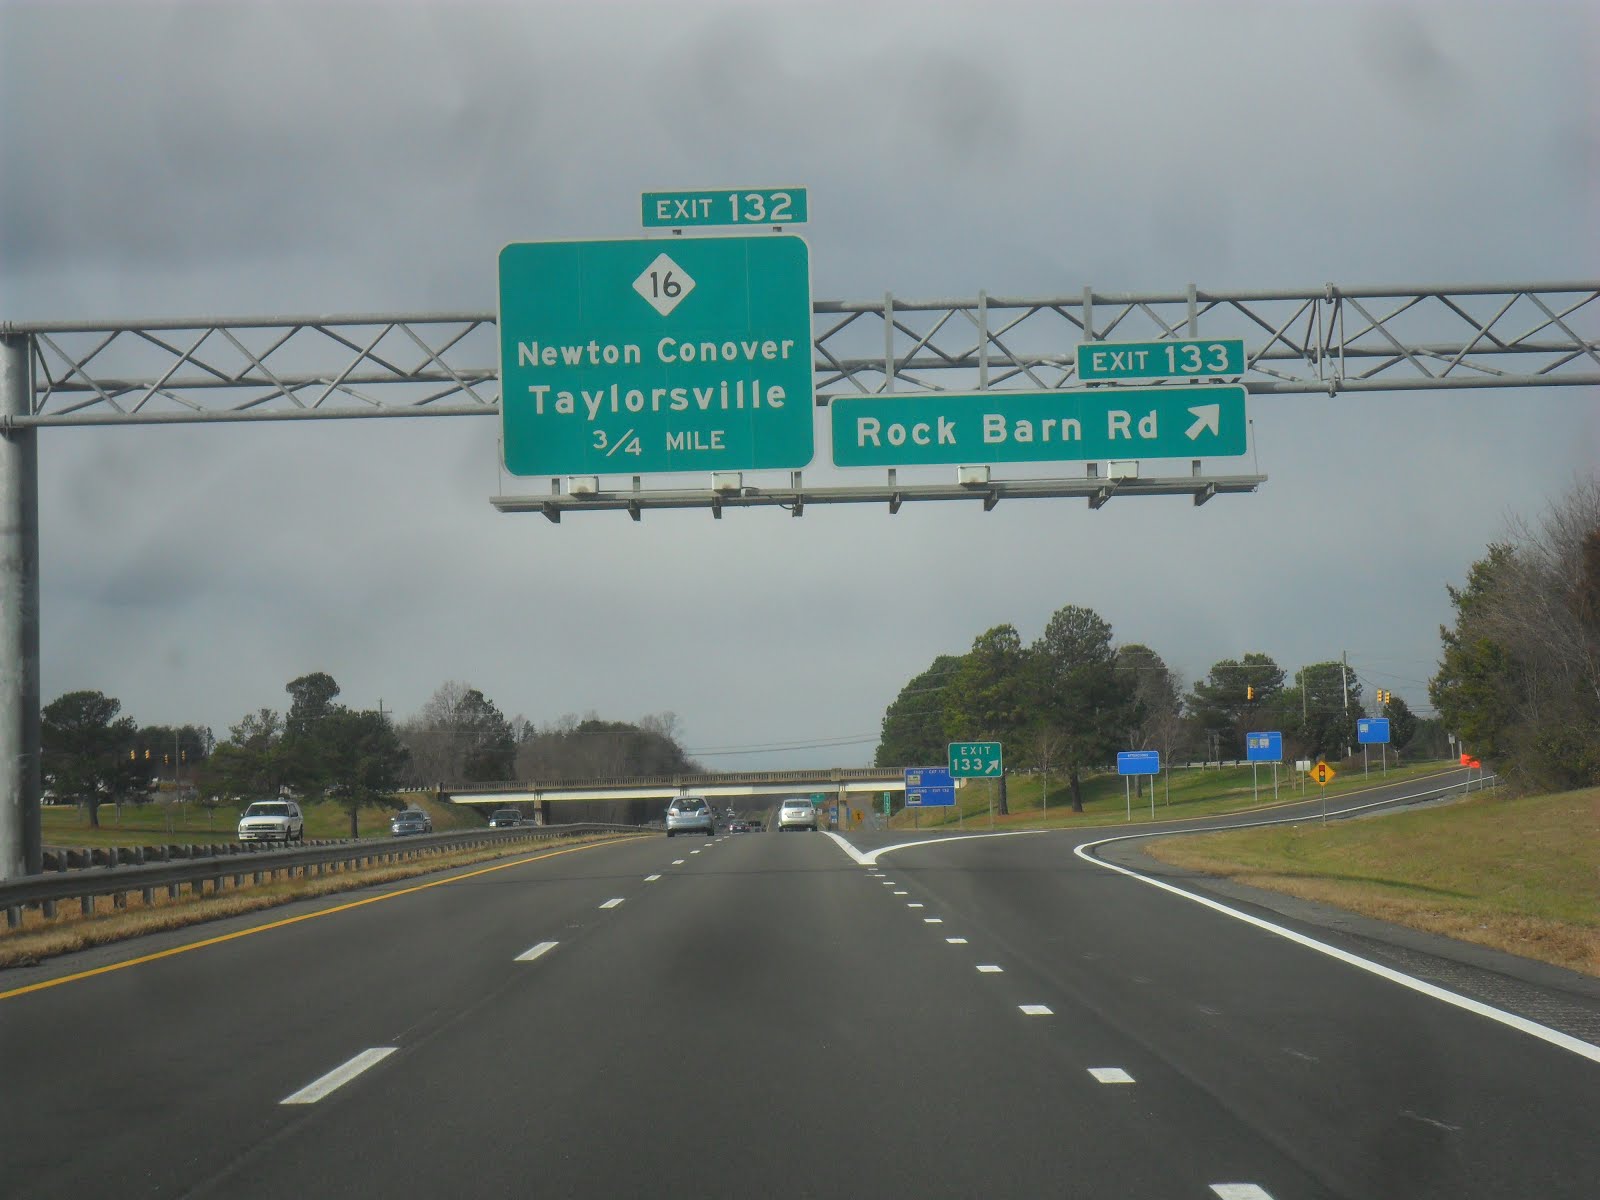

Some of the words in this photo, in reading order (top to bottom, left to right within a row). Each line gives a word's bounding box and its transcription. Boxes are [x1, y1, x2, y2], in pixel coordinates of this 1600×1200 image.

[657, 199, 713, 219] EXIT
[728, 193, 793, 221] 132
[650, 270, 682, 298] 16
[518, 340, 641, 366] Newton
[657, 337, 794, 363] Conover
[1093, 351, 1149, 371] EXIT
[1165, 344, 1229, 373] 133
[528, 379, 786, 420] Taylorsville
[592, 428, 642, 457] 3/4
[666, 430, 725, 451] MILE
[857, 415, 957, 447] Rock
[983, 413, 1082, 443] Barn
[1107, 410, 1158, 440] Rd
[953, 758, 983, 771] 133
[961, 746, 991, 755] EXIT
